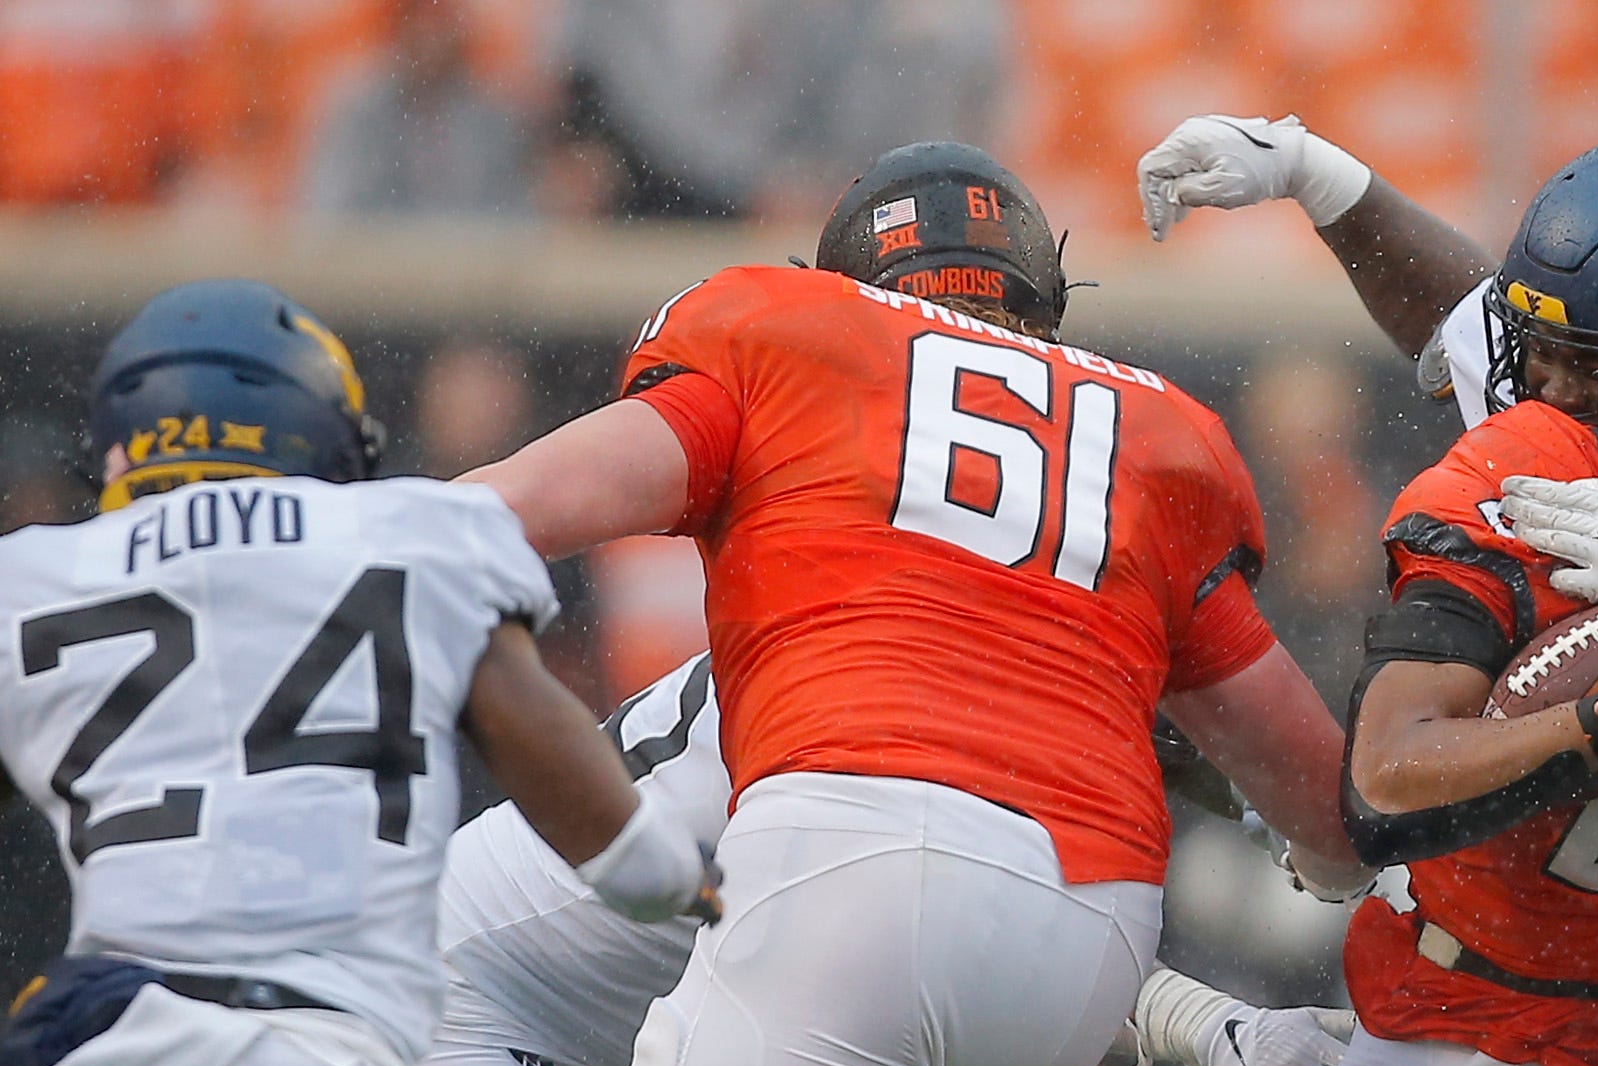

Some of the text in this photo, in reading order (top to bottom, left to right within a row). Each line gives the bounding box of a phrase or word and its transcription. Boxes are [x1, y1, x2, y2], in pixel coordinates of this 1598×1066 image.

[963, 186, 1003, 222] 61
[897, 267, 1006, 299] COWBOYS
[157, 414, 211, 457] 24
[890, 331, 1120, 592] 61
[125, 491, 303, 576] FLOYD
[19, 565, 429, 864] 24
